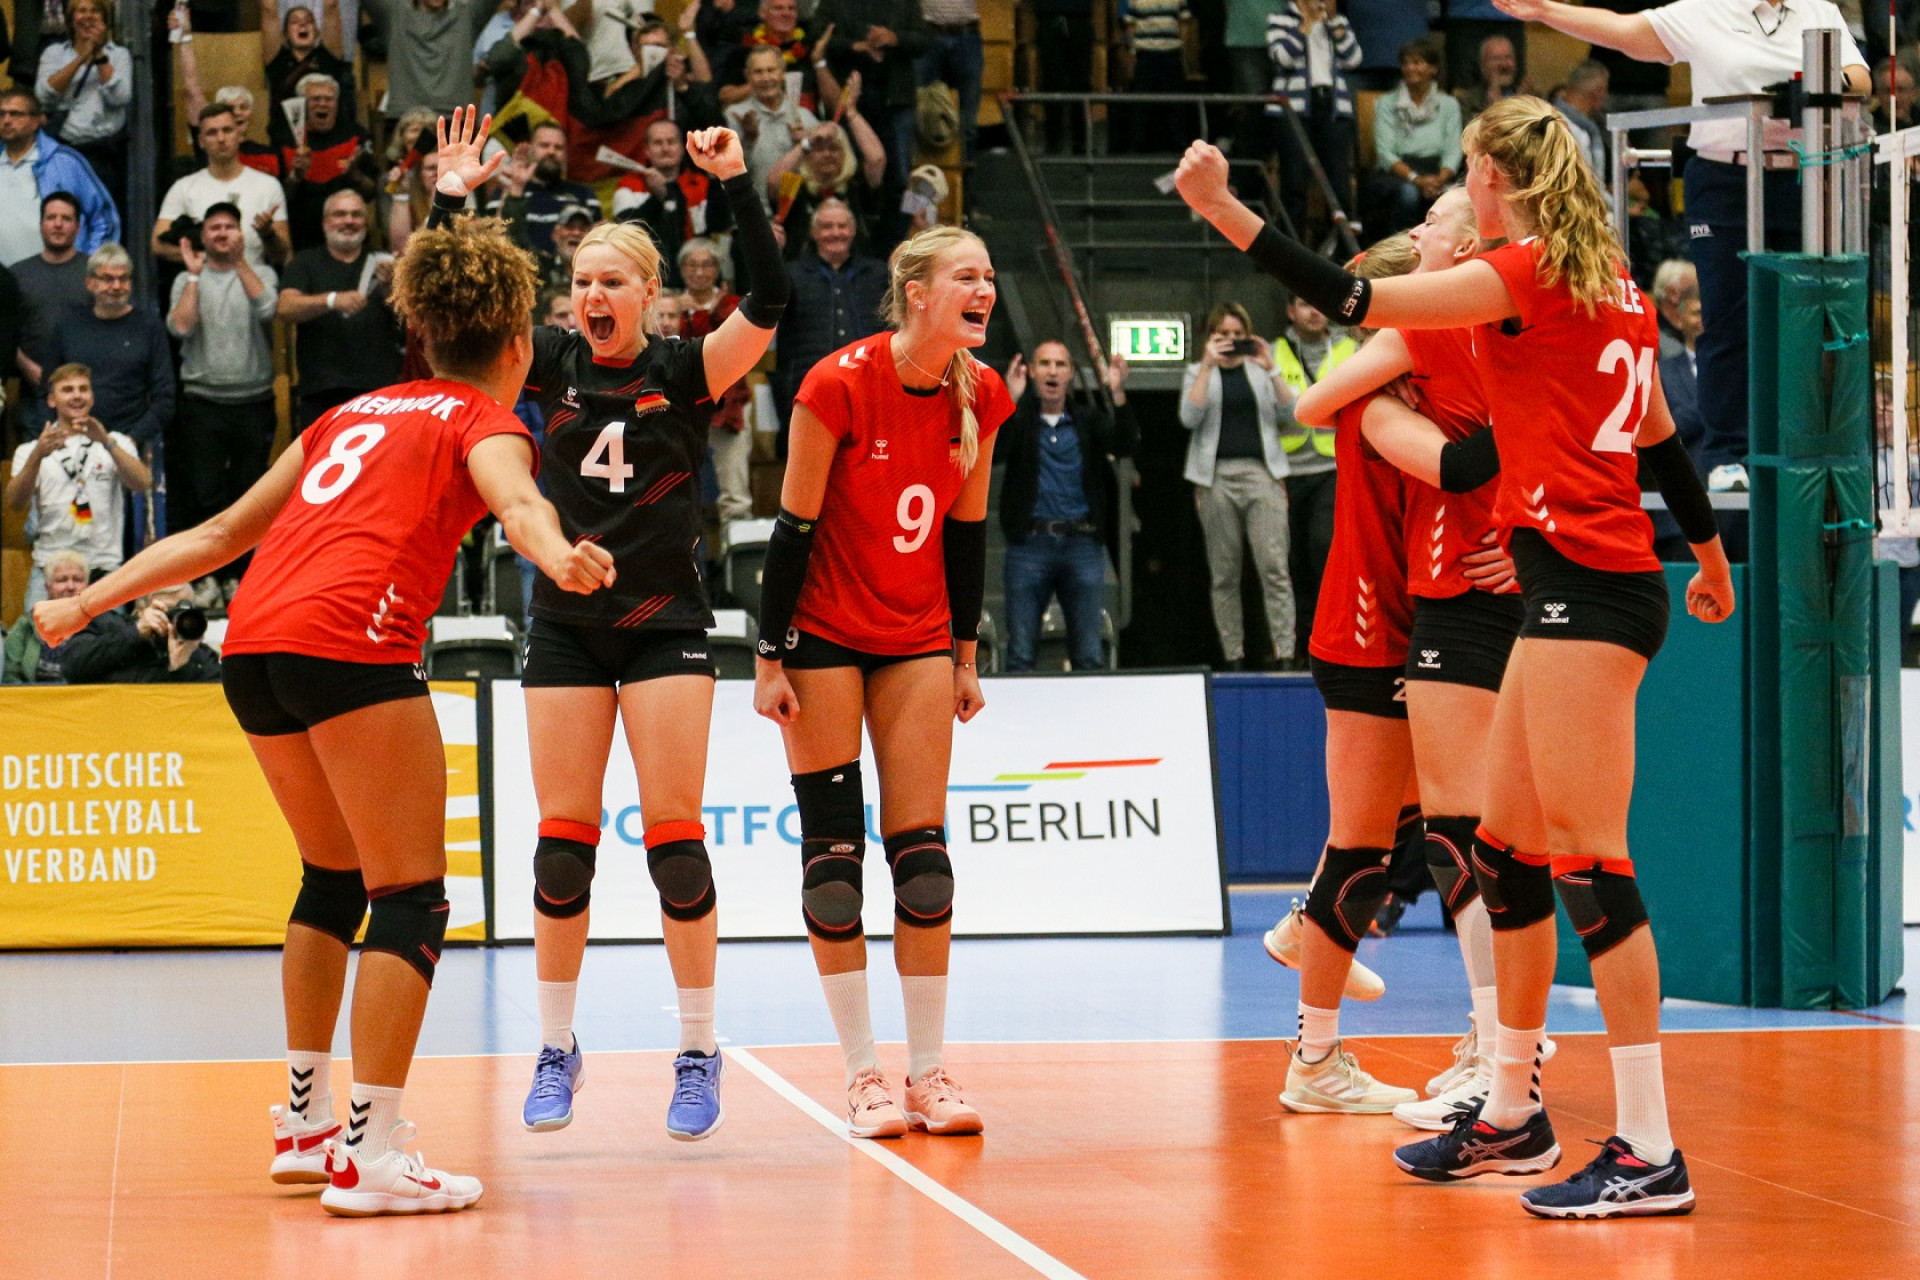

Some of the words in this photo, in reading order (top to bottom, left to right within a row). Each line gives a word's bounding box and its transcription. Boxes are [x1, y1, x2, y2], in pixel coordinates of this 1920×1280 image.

[1591, 338, 1655, 457] 21
[301, 423, 386, 505] 8
[580, 421, 634, 493] 4
[892, 483, 936, 554] 9
[784, 626, 800, 650] 9
[1541, 616, 1569, 624] hummel
[1417, 661, 1441, 669] hummel
[3, 752, 185, 790] DEUTSCHER
[4, 799, 202, 837] VOLLEYBALL
[969, 798, 1161, 843] BERLIN
[4, 847, 157, 884] VERBAND
